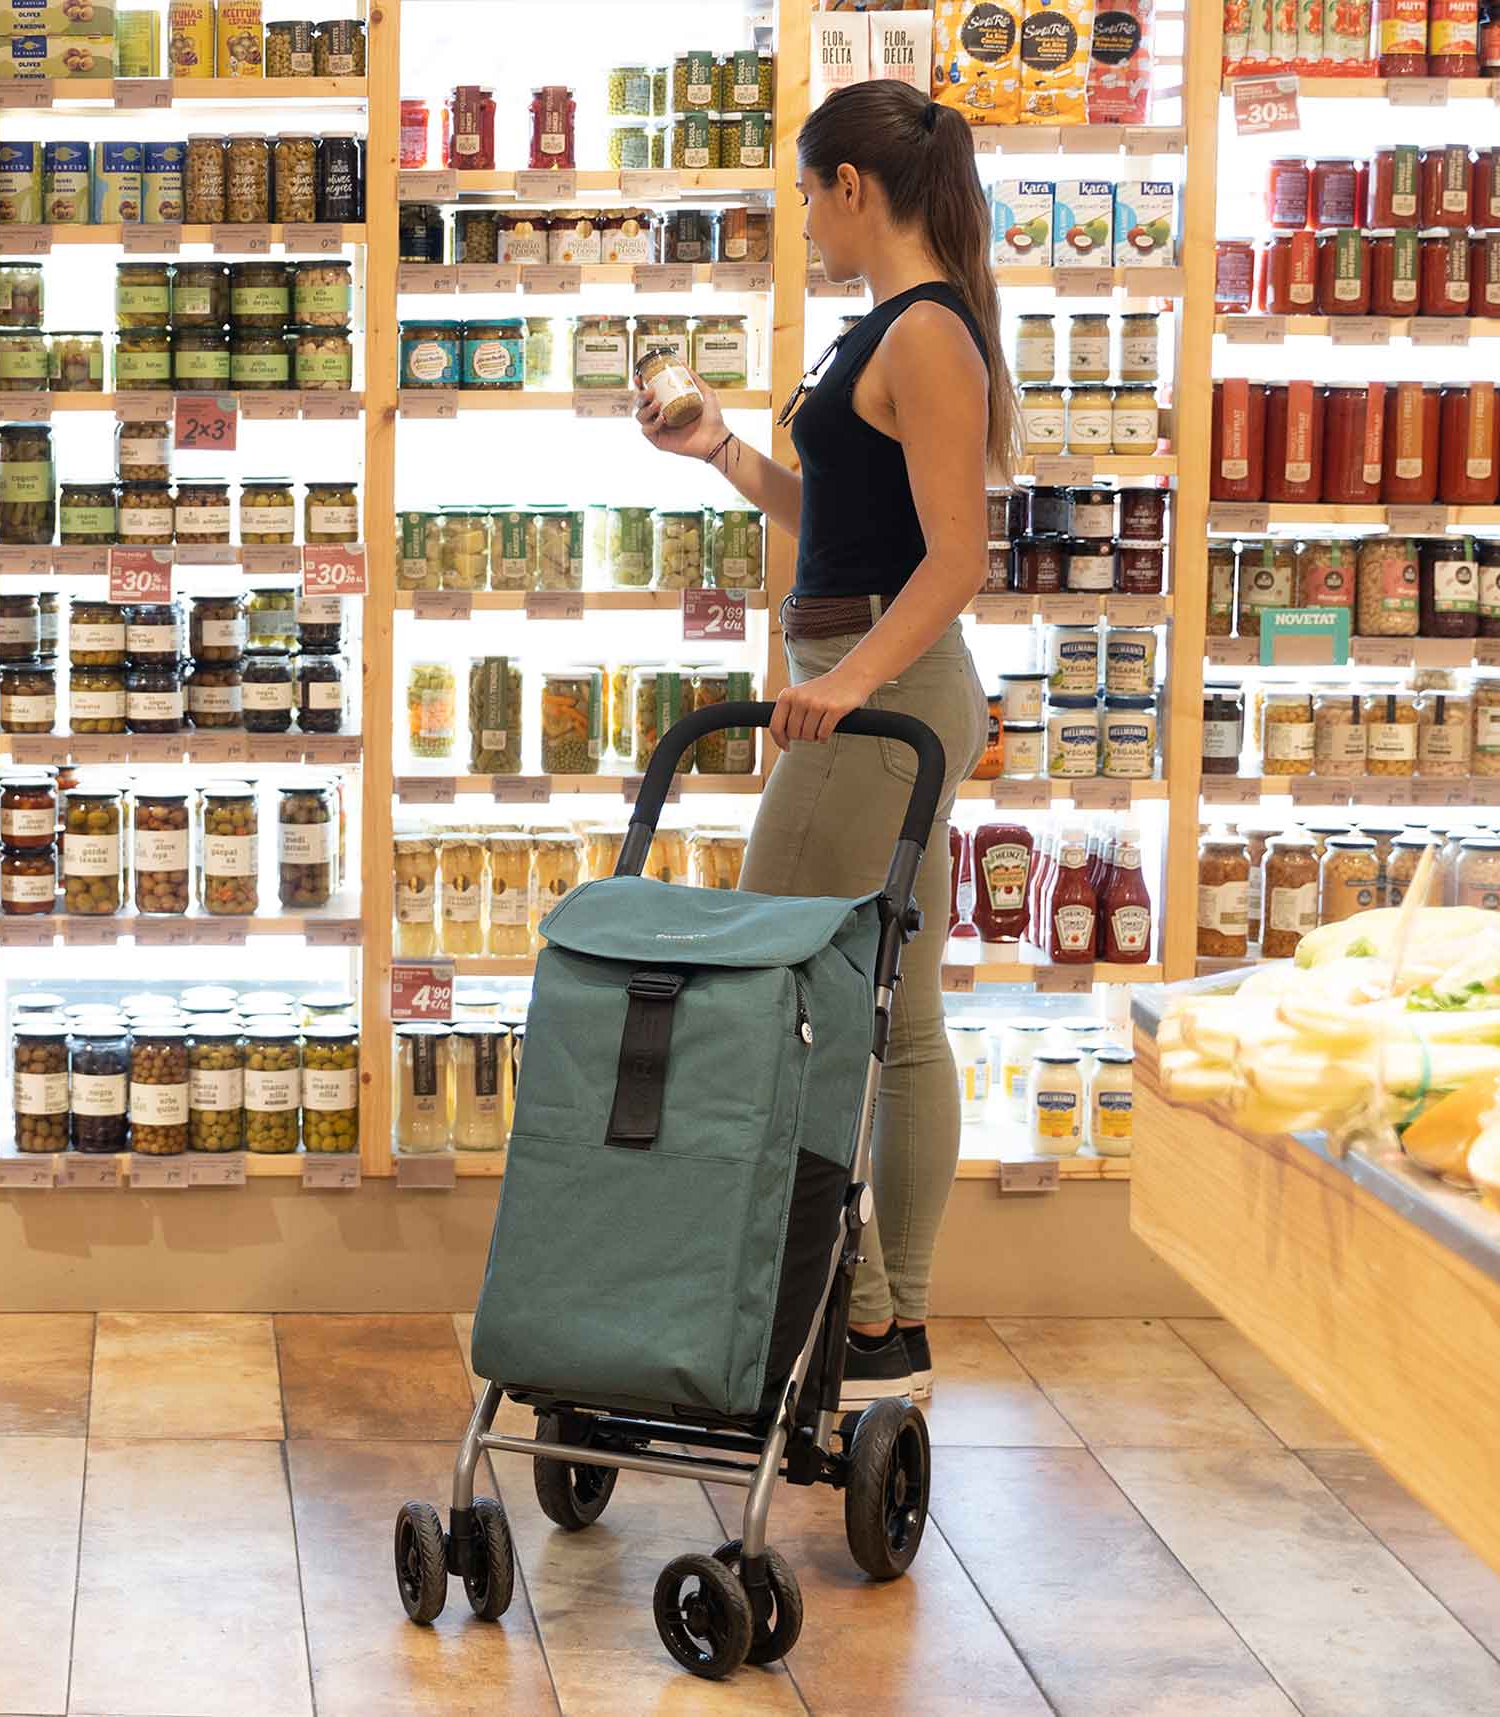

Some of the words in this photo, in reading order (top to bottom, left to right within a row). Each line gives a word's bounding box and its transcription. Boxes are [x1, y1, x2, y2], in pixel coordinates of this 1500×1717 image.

[823, 31, 844, 46] FLOR
[884, 30, 907, 46] FLOR
[822, 48, 852, 64] DELTA
[884, 48, 914, 64] DELTA
[325, 184, 353, 196] negres
[1021, 182, 1049, 195] kara
[1081, 182, 1109, 195] kara
[1143, 182, 1171, 195] kara
[1274, 613, 1337, 625] NOVETAT
[996, 851, 1020, 859] HEINZ
